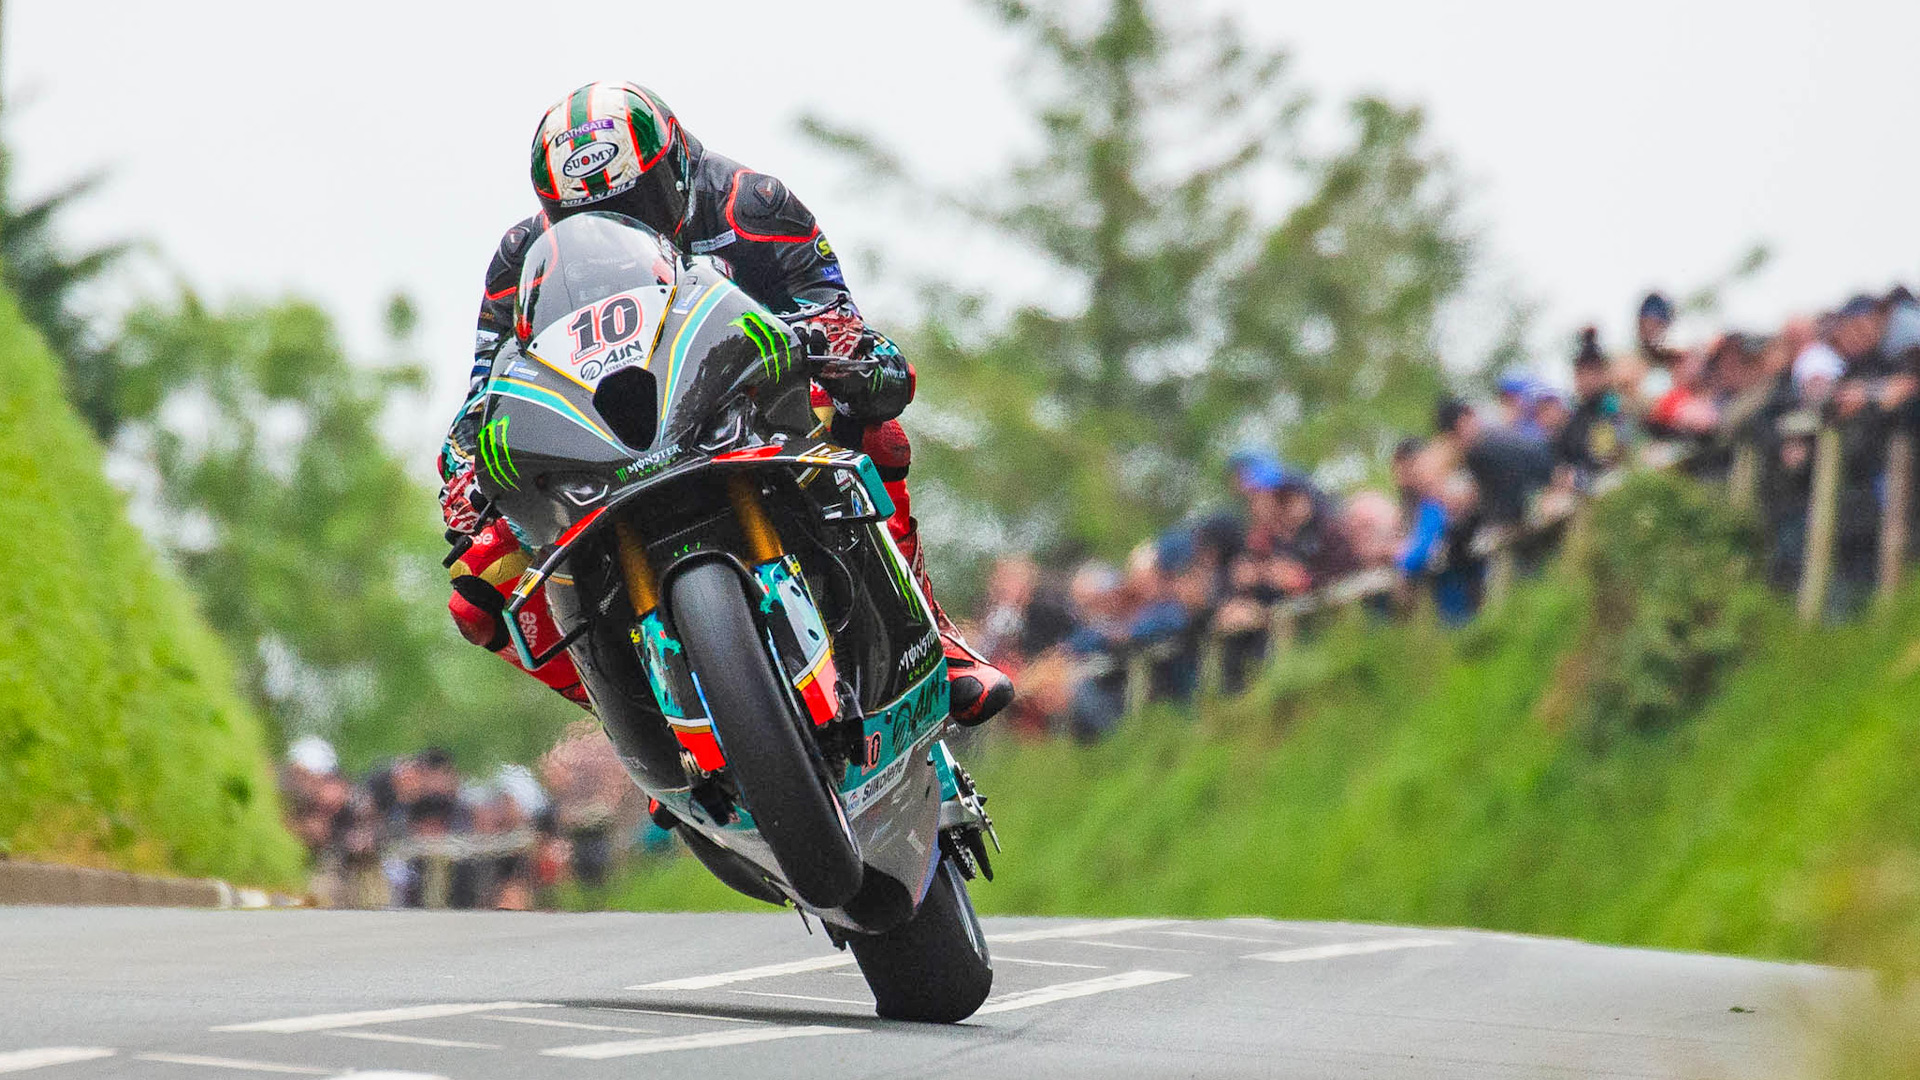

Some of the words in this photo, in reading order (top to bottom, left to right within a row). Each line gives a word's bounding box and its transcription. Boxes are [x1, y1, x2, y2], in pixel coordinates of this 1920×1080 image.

[557, 120, 610, 145] BATHGATE
[566, 148, 613, 172] SUOMY
[568, 295, 642, 364] 10
[603, 340, 643, 366] AJN
[627, 444, 682, 473] MONSTER
